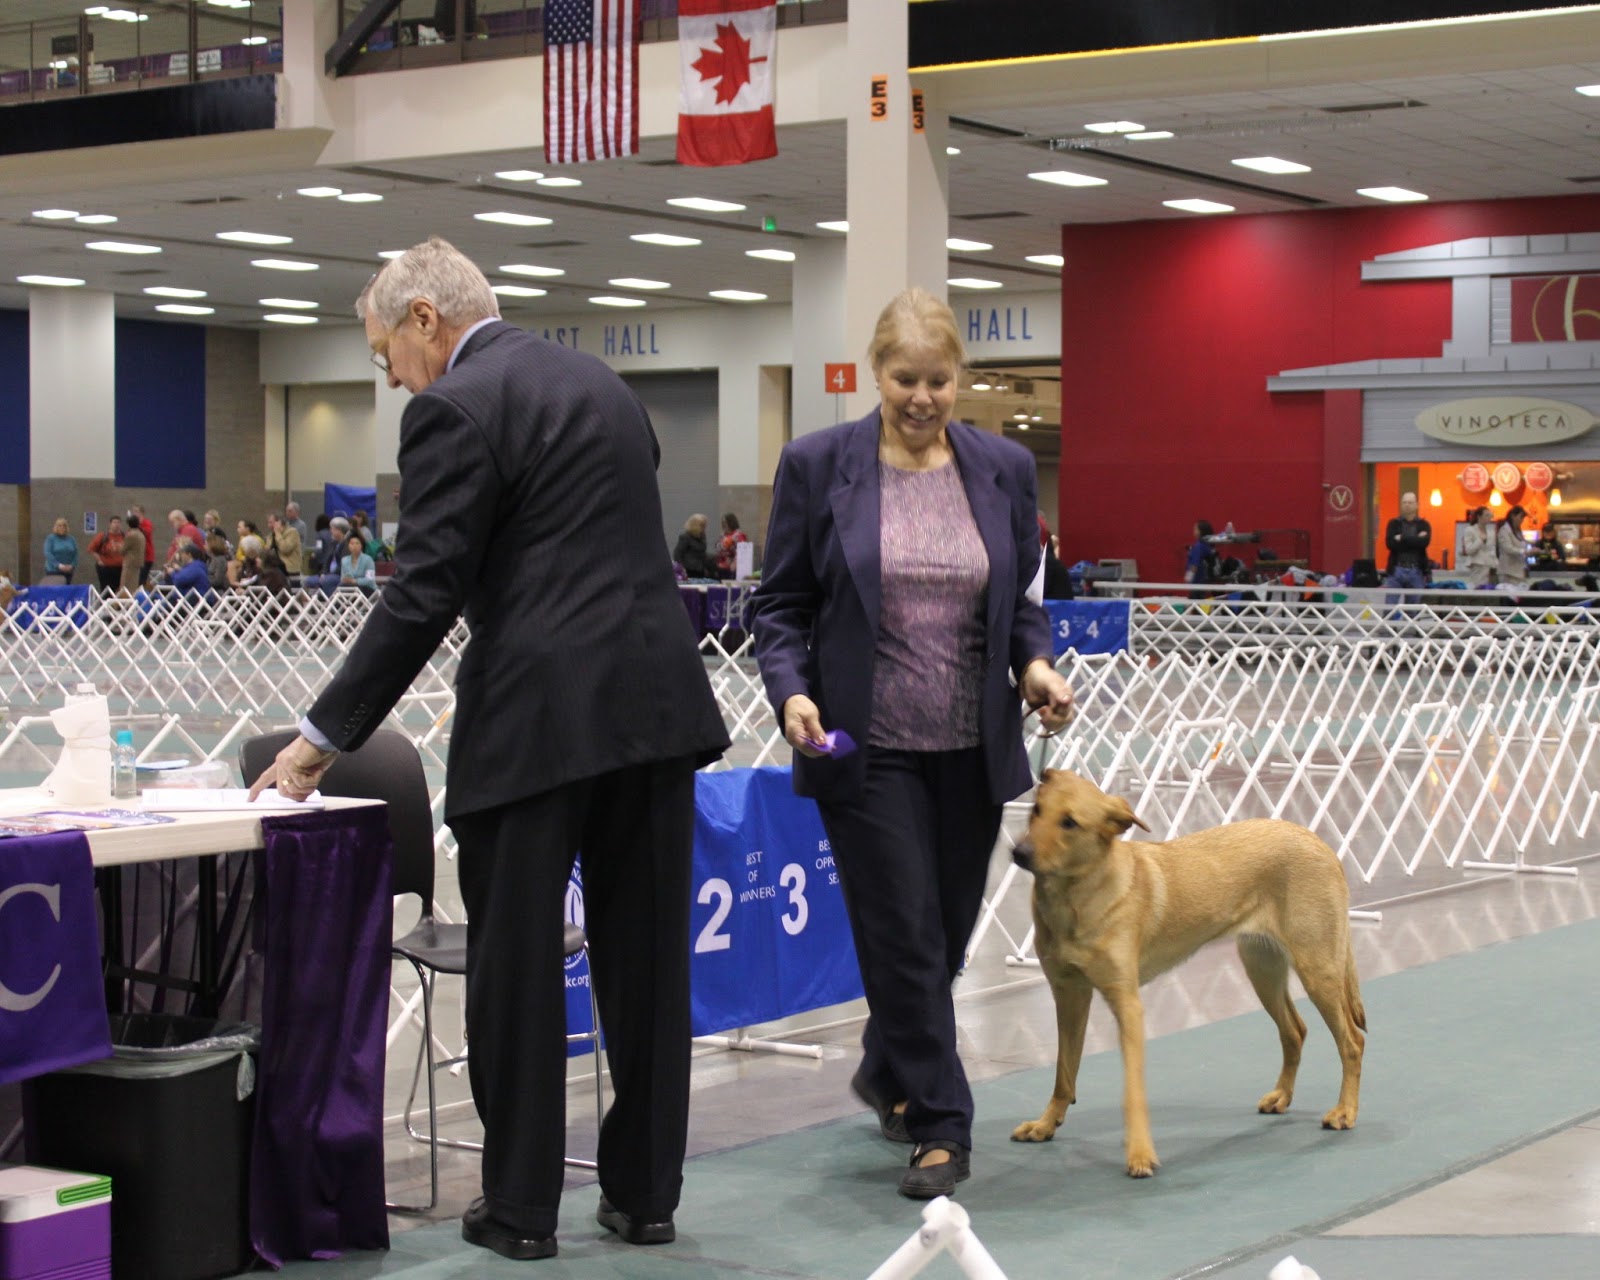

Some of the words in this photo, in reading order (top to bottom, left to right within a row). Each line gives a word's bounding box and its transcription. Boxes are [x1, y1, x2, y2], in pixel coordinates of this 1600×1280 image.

[968, 306, 1032, 341] HALL
[604, 323, 660, 355] HALL
[833, 369, 845, 389] 4
[1442, 414, 1566, 429] VINOTECA
[1335, 491, 1348, 506] V
[1058, 619, 1070, 638] 3
[1086, 620, 1099, 639] 4
[746, 851, 763, 866] BEST
[748, 870, 758, 883] OF
[740, 885, 776, 904] WINNERS
[779, 862, 809, 936] 3
[694, 877, 733, 954] 2
